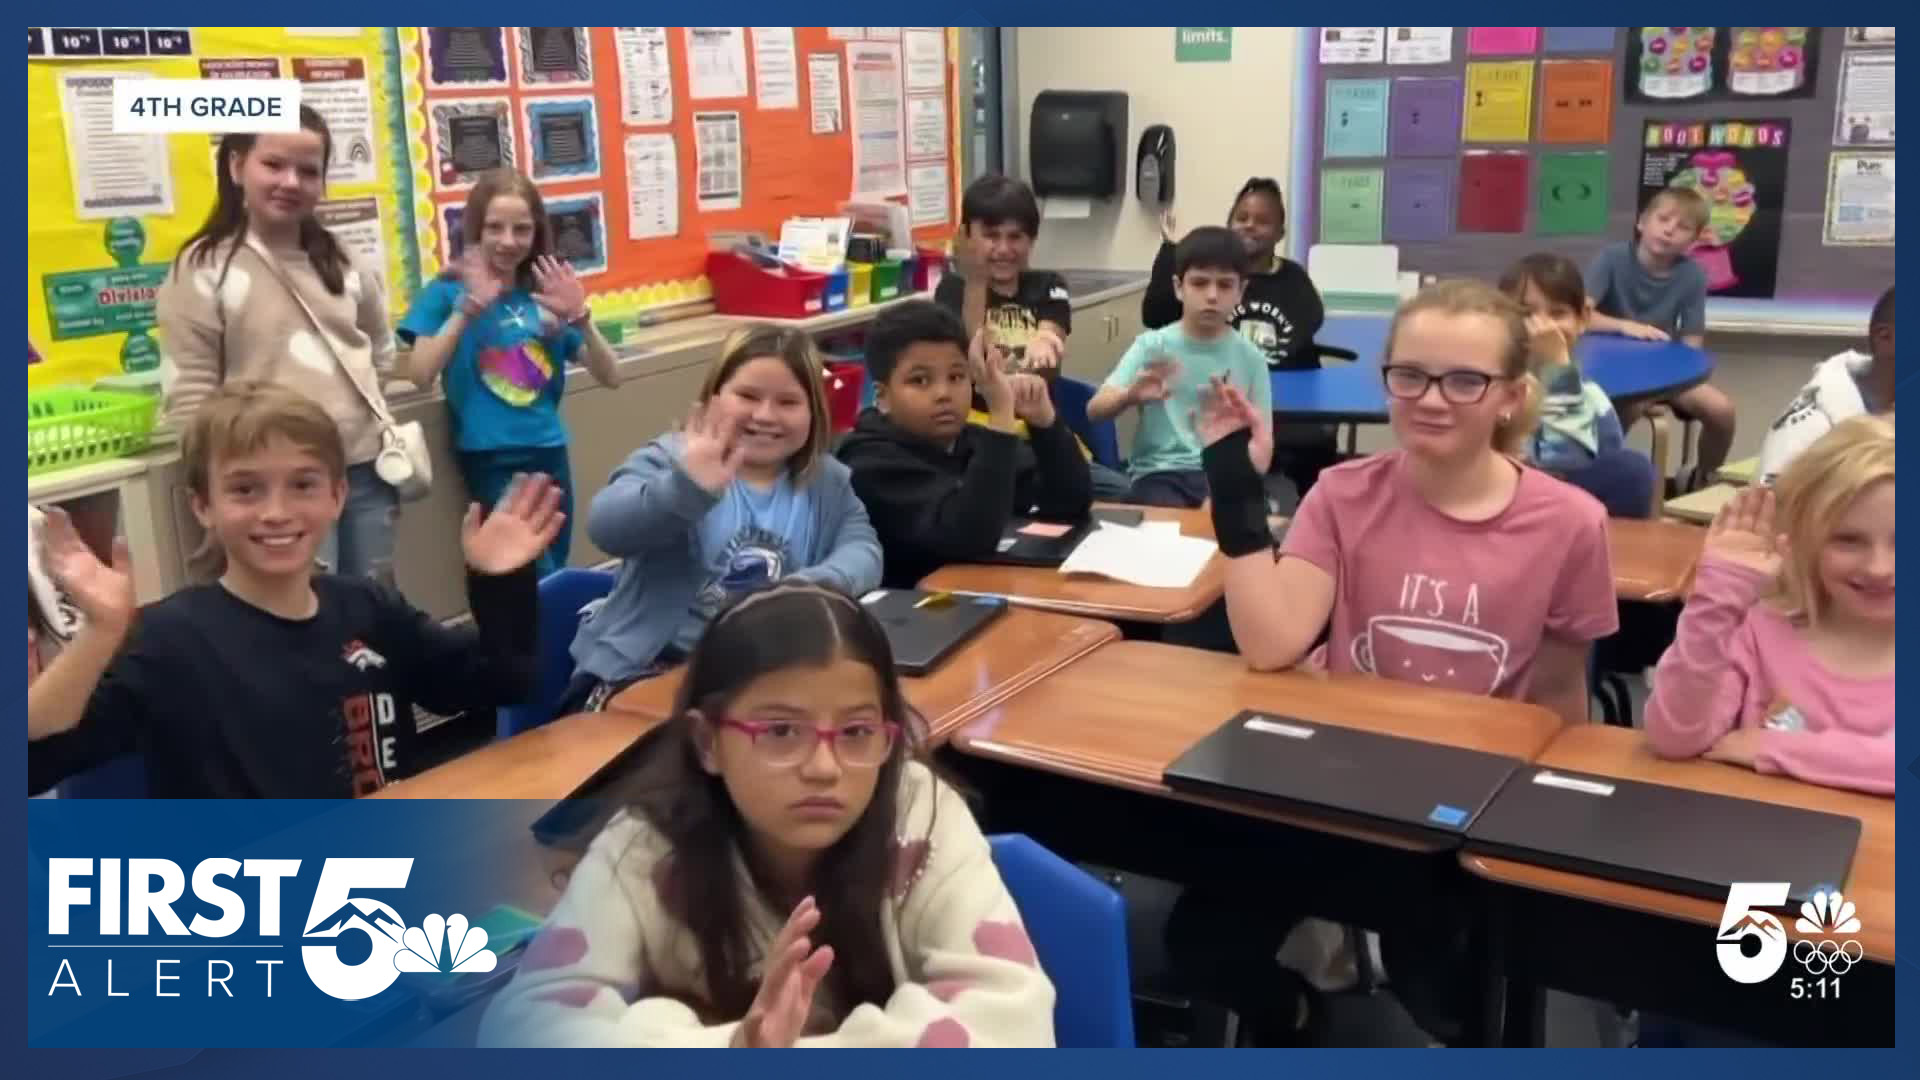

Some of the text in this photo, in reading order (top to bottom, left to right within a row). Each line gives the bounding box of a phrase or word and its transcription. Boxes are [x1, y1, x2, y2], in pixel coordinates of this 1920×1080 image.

[98, 287, 158, 305] Divisio
[1399, 573, 1479, 625] IT'S A
[376, 693, 397, 769] DE
